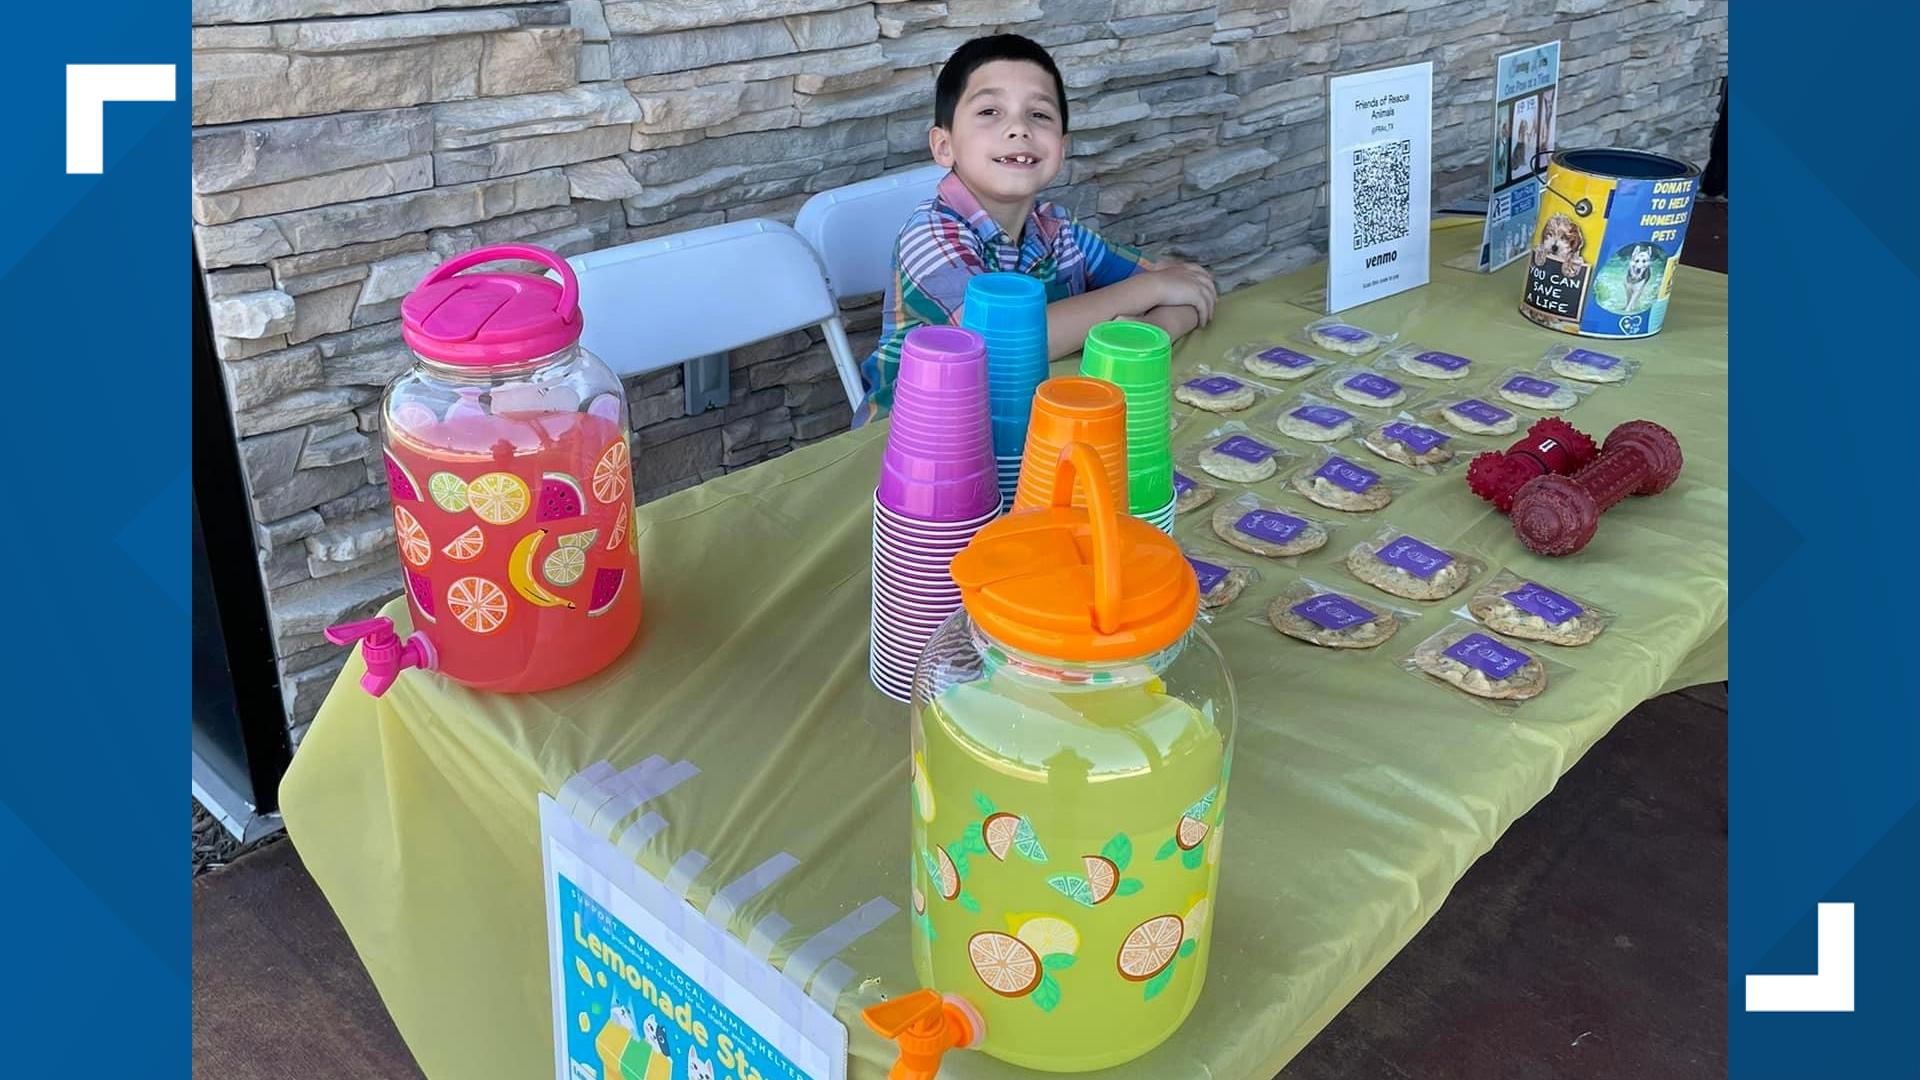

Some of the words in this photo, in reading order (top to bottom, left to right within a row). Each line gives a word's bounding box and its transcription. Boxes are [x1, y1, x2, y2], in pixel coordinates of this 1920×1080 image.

[1355, 98, 1379, 110] Friends
[1380, 94, 1388, 106] of
[1388, 93, 1410, 105] Rescue
[1371, 107, 1395, 119] Animals
[1652, 180, 1693, 194] DONATE
[1651, 198, 1667, 210] TO
[1668, 196, 1690, 210] HELP
[1640, 212, 1688, 226] HOMELESS
[1651, 229, 1677, 242] PETS
[1366, 250, 1397, 269] venmo
[1529, 265, 1546, 280] YOU
[1550, 275, 1580, 289] CAN
[1533, 281, 1562, 299] SAVE
[1526, 293, 1533, 302] A
[1535, 295, 1569, 313] LIFE
[571, 888, 617, 931] SUPPORT
[670, 968, 705, 1004] LOCAL
[573, 911, 708, 1048] Lemonade
[716, 1033, 769, 1080] Sta
